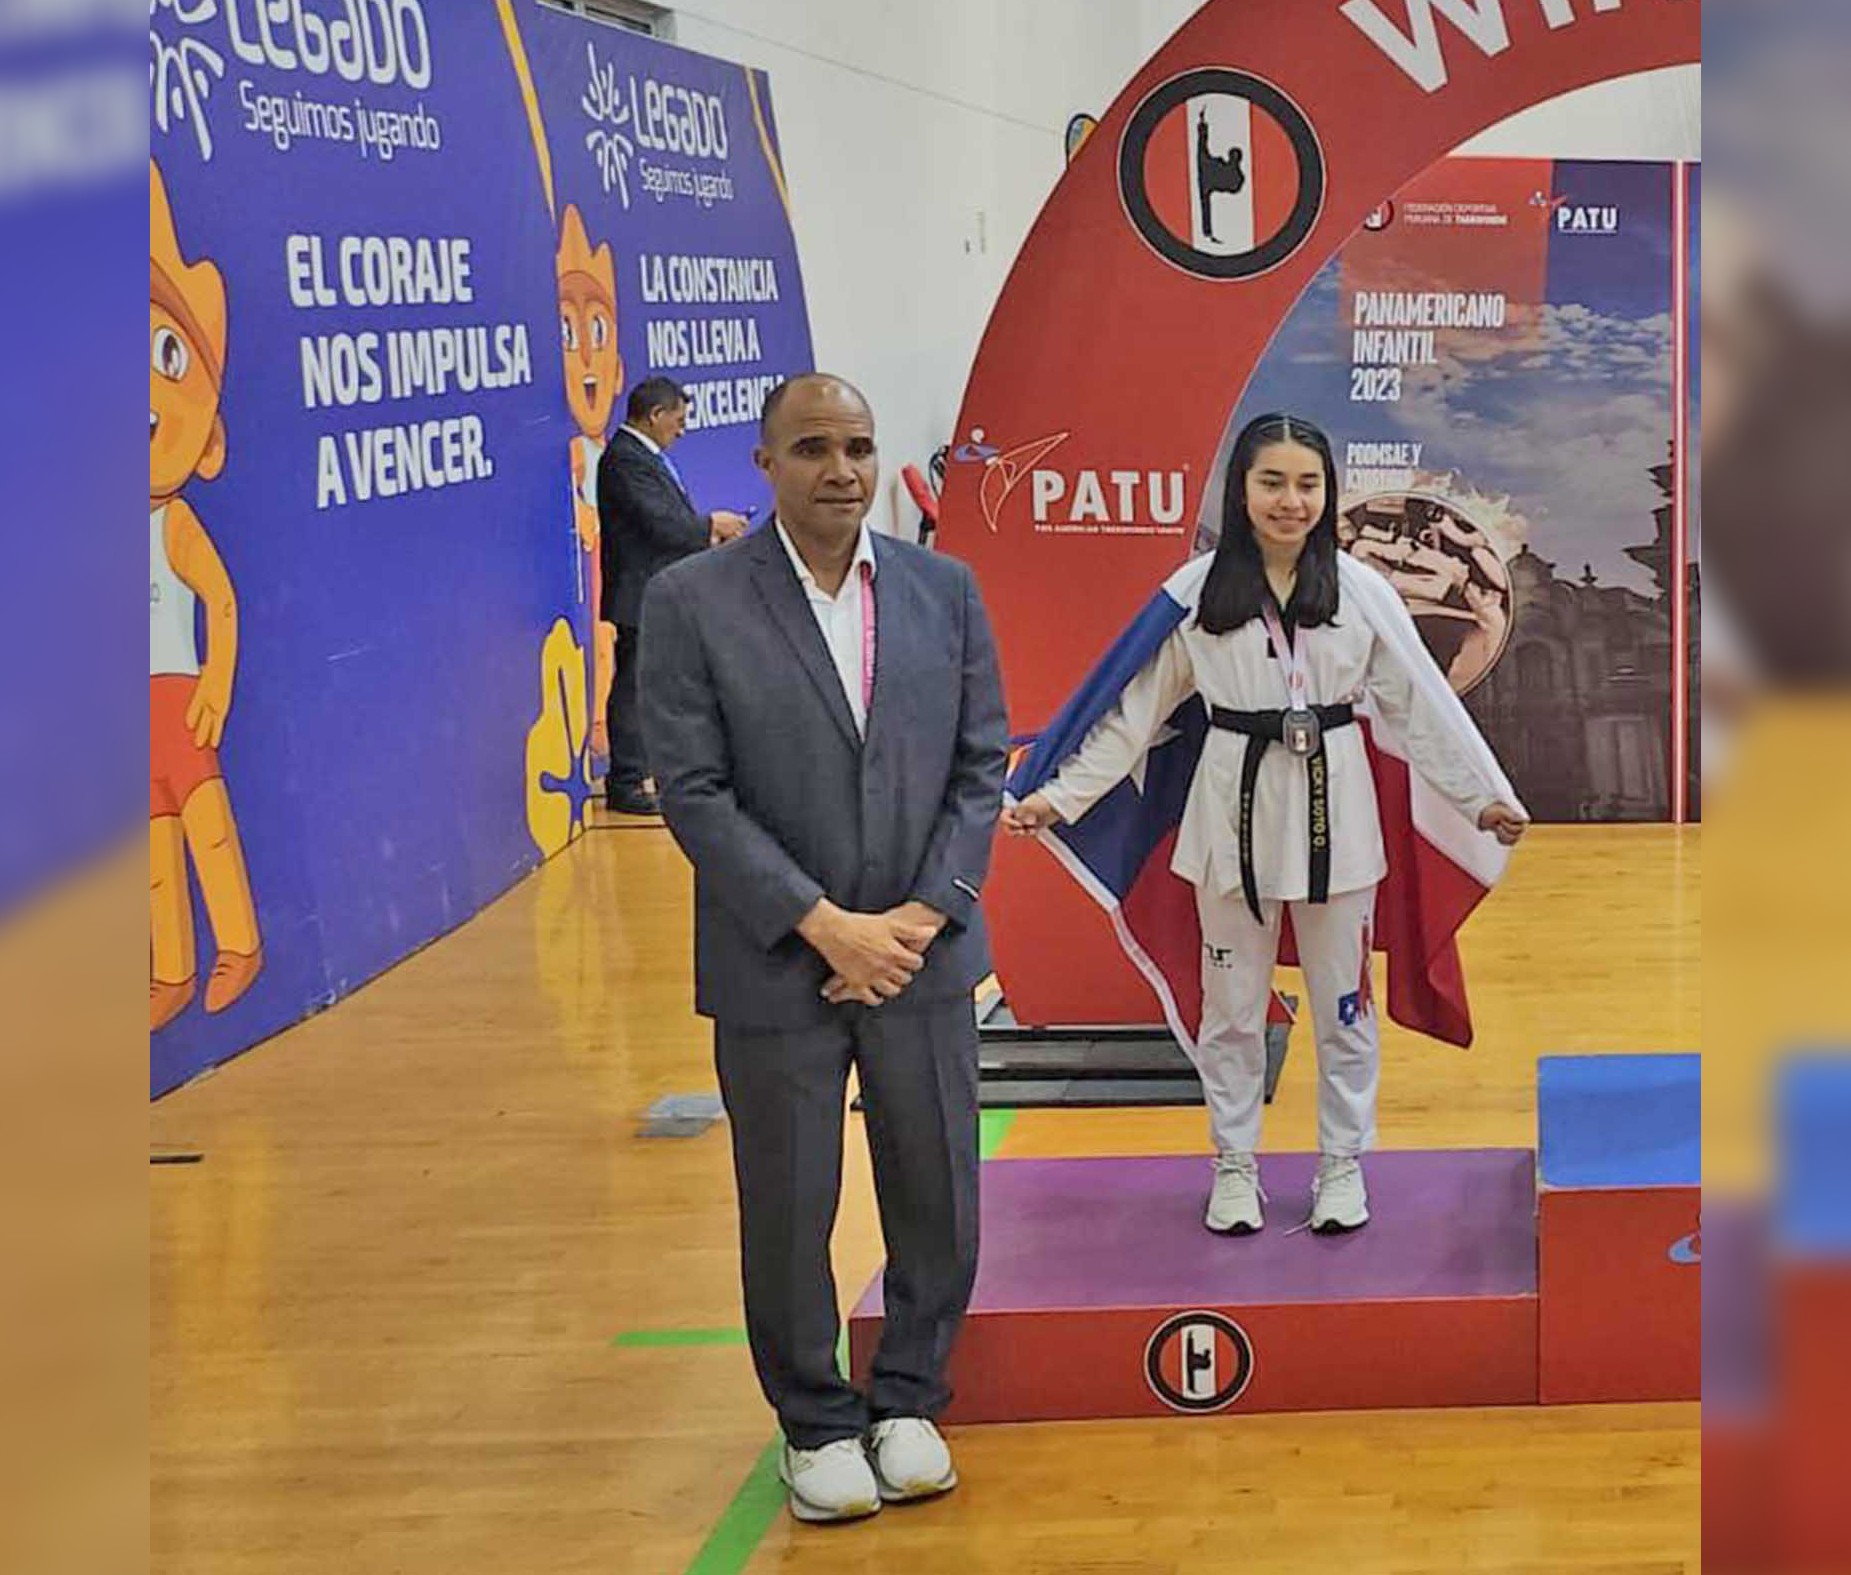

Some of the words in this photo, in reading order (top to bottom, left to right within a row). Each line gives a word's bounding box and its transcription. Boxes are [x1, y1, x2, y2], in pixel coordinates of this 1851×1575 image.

[239, 80, 355, 151] Seguimos
[354, 99, 441, 160] jugando
[638, 157, 694, 203] Seguimos
[692, 167, 735, 208] jugando
[1557, 206, 1618, 229] PATU
[286, 234, 338, 308] EL
[339, 236, 474, 307] CORAJE
[639, 253, 669, 303] LA
[668, 256, 779, 304] CONSTANCIA
[1353, 292, 1506, 328] PANAMERICANO
[301, 332, 383, 409] NOS
[386, 324, 532, 399] IMPULSA
[647, 319, 690, 369] NOS
[690, 318, 746, 366] LLEVA
[747, 317, 762, 362] A
[1352, 330, 1438, 364] INFANTIL
[1350, 367, 1402, 402] 2023
[316, 436, 348, 509] A
[345, 414, 493, 502] VENCER.
[1031, 469, 1185, 524] PATU
